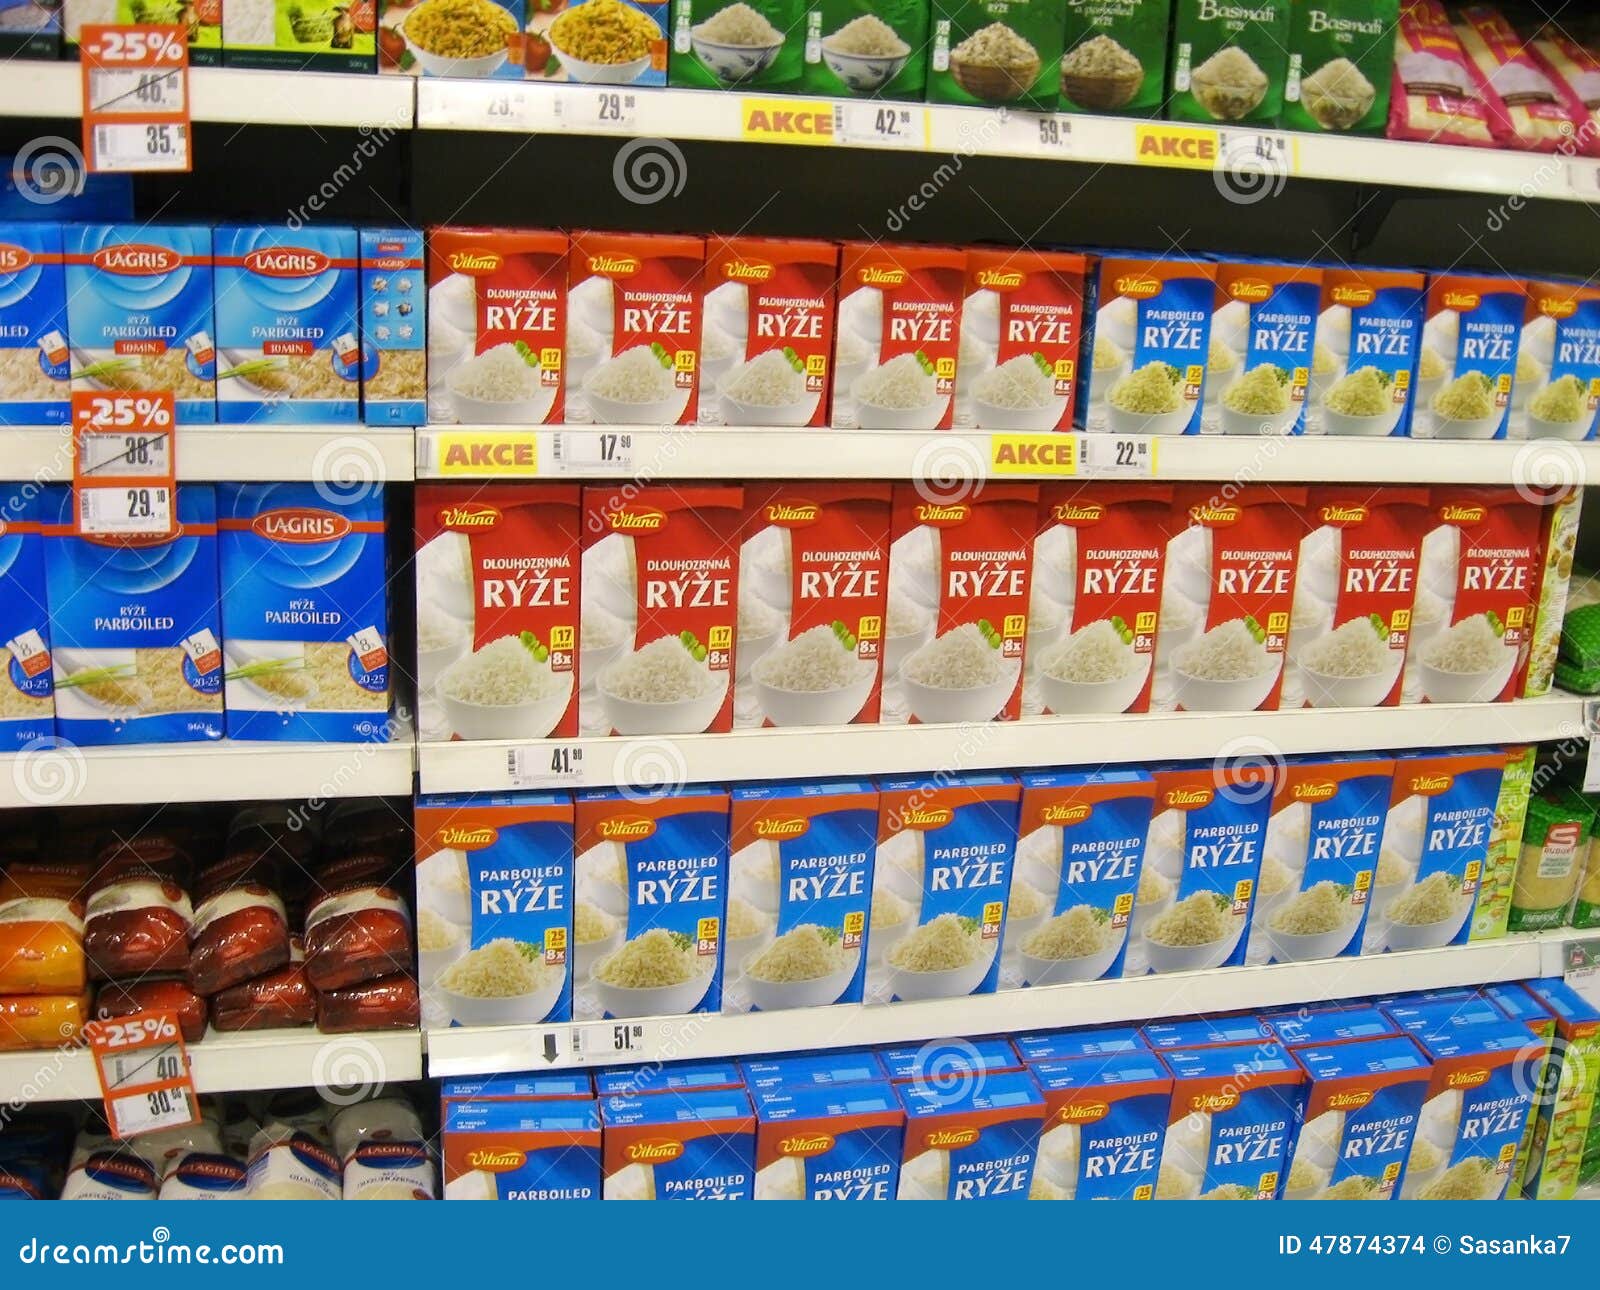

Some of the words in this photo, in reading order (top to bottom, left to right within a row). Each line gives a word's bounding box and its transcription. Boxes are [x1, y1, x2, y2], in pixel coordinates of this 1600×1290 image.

[1309, 10, 1382, 35] Basmati
[88, 32, 183, 62] -25%
[747, 109, 832, 135] AKCE
[1140, 134, 1214, 160] AKCE
[105, 253, 168, 268] LAGRIS
[256, 253, 318, 270] LAGRIS
[450, 253, 500, 271] Vitana
[589, 255, 639, 273] Vitana
[724, 261, 774, 280] Vitana
[861, 267, 906, 283] Vitana
[979, 270, 1024, 287] Vitana
[487, 288, 557, 301] DLOUHOZRNNÁ
[1116, 278, 1158, 294] Vitana
[624, 291, 692, 304] DLOUHOZRNNÁ
[759, 297, 825, 309] DLOUHOZRNNÁ
[487, 300, 556, 331] RÝŽE
[893, 301, 954, 313] DLOUHOZRNNÁ
[1010, 304, 1072, 315] DLOUHOZRNNÁ
[624, 302, 691, 334] RÝŽE
[757, 308, 822, 338] RÝŽE
[1146, 310, 1204, 322] PARBOILED
[1258, 313, 1311, 325] PARBOILED
[1359, 317, 1412, 329] PARBOILED
[103, 326, 177, 338] PARBOILED
[252, 326, 324, 339] PARBOILED
[891, 311, 952, 342] RÝŽE
[1009, 313, 1071, 344] RÝŽE
[1467, 323, 1515, 334] PARBOILED
[1144, 321, 1202, 350] RÝŽE
[1255, 324, 1308, 352] RÝŽE
[1357, 327, 1411, 355] RÝŽE
[1463, 333, 1512, 360] RÝŽE
[80, 398, 170, 426] -25%
[445, 444, 533, 465] AKCE
[996, 445, 1072, 465] AKCE
[442, 508, 499, 526] Vitana
[610, 510, 664, 528] Vitana
[767, 504, 818, 521] Vitana
[916, 504, 967, 521] Vitana
[1054, 503, 1102, 520] Vitana
[1191, 504, 1240, 521] Vitana
[1322, 506, 1366, 522] Vitana
[1441, 505, 1484, 521] Vitana
[266, 516, 335, 535] LAGRIS
[802, 548, 881, 562] DLOUHOZRNNÁ
[951, 549, 1026, 562] DLOUHOZRNNÁ
[1086, 548, 1159, 560] DLOUHOZRNNÁ
[1221, 550, 1292, 561] DLOUHOZRNNÁ
[1350, 548, 1415, 560] DLOUHOZRNNÁ
[1467, 547, 1530, 559] DLOUHOZRNNÁ
[483, 554, 571, 570] DLOUHOZRNNÁ
[647, 556, 731, 570] DLOUHOZRNNÁ
[801, 561, 880, 599] RÝŽE
[949, 561, 1025, 598] RÝŽE
[1083, 560, 1157, 594] RÝŽE
[1218, 561, 1290, 594] RÝŽE
[1346, 560, 1413, 593] RÝŽE
[1463, 559, 1528, 590] RÝŽE
[483, 569, 570, 608] RÝŽE
[646, 571, 729, 608] RÝŽE
[94, 617, 174, 632] PARBOILED
[265, 611, 341, 625] PARBOILED
[1294, 781, 1337, 798] Vitana
[1411, 775, 1452, 792] Vitana
[1167, 789, 1211, 805] Vitana
[903, 808, 953, 825] Vitana
[1042, 804, 1089, 821] Vitana
[1434, 807, 1489, 823] PARBOILED
[600, 818, 653, 836] Vitana
[754, 818, 806, 835] Vitana
[1194, 823, 1259, 839] PARBOILED
[1318, 815, 1380, 830] PARBOILED
[439, 827, 494, 845] Vitana
[1314, 828, 1378, 860] RÝŽE
[1430, 820, 1486, 851] RÝŽE
[934, 843, 1006, 860] PARBOILED
[1072, 838, 1141, 854] PARBOILED
[1190, 835, 1257, 869] RÝŽE
[637, 857, 718, 873] PARBOILED
[790, 853, 866, 869] PARBOILED
[1067, 850, 1138, 884] RÝŽE
[480, 866, 564, 882] PARBOILED
[932, 856, 1005, 892] RÝŽE
[637, 870, 717, 905] RÝŽE
[788, 866, 865, 902] RÝŽE
[481, 879, 564, 915] RÝŽE
[96, 1016, 177, 1047] -25%
[1327, 1091, 1371, 1108] Vitana
[1469, 1094, 1527, 1113] PARBOILED
[1059, 1103, 1105, 1120] Vitana
[1219, 1120, 1285, 1138] PARBOILED
[1351, 1115, 1413, 1133] PARBOILED
[1463, 1107, 1523, 1140] RÝŽE
[780, 1136, 832, 1152] Vitana
[928, 1130, 977, 1145] Vitana
[1089, 1131, 1158, 1150] PARBOILED
[1344, 1127, 1409, 1159] RÝŽE
[629, 1141, 680, 1158] Vitana
[1214, 1133, 1283, 1166] RÝŽE
[471, 1151, 522, 1167] Vitana
[958, 1154, 1030, 1174] PARBOILED
[1086, 1143, 1156, 1179] RÝŽE
[815, 1165, 890, 1184] PARBOILED
[665, 1174, 745, 1193] PARBOILED
[955, 1167, 1027, 1200] RÝŽE
[508, 1187, 591, 1200] PARBOILED
